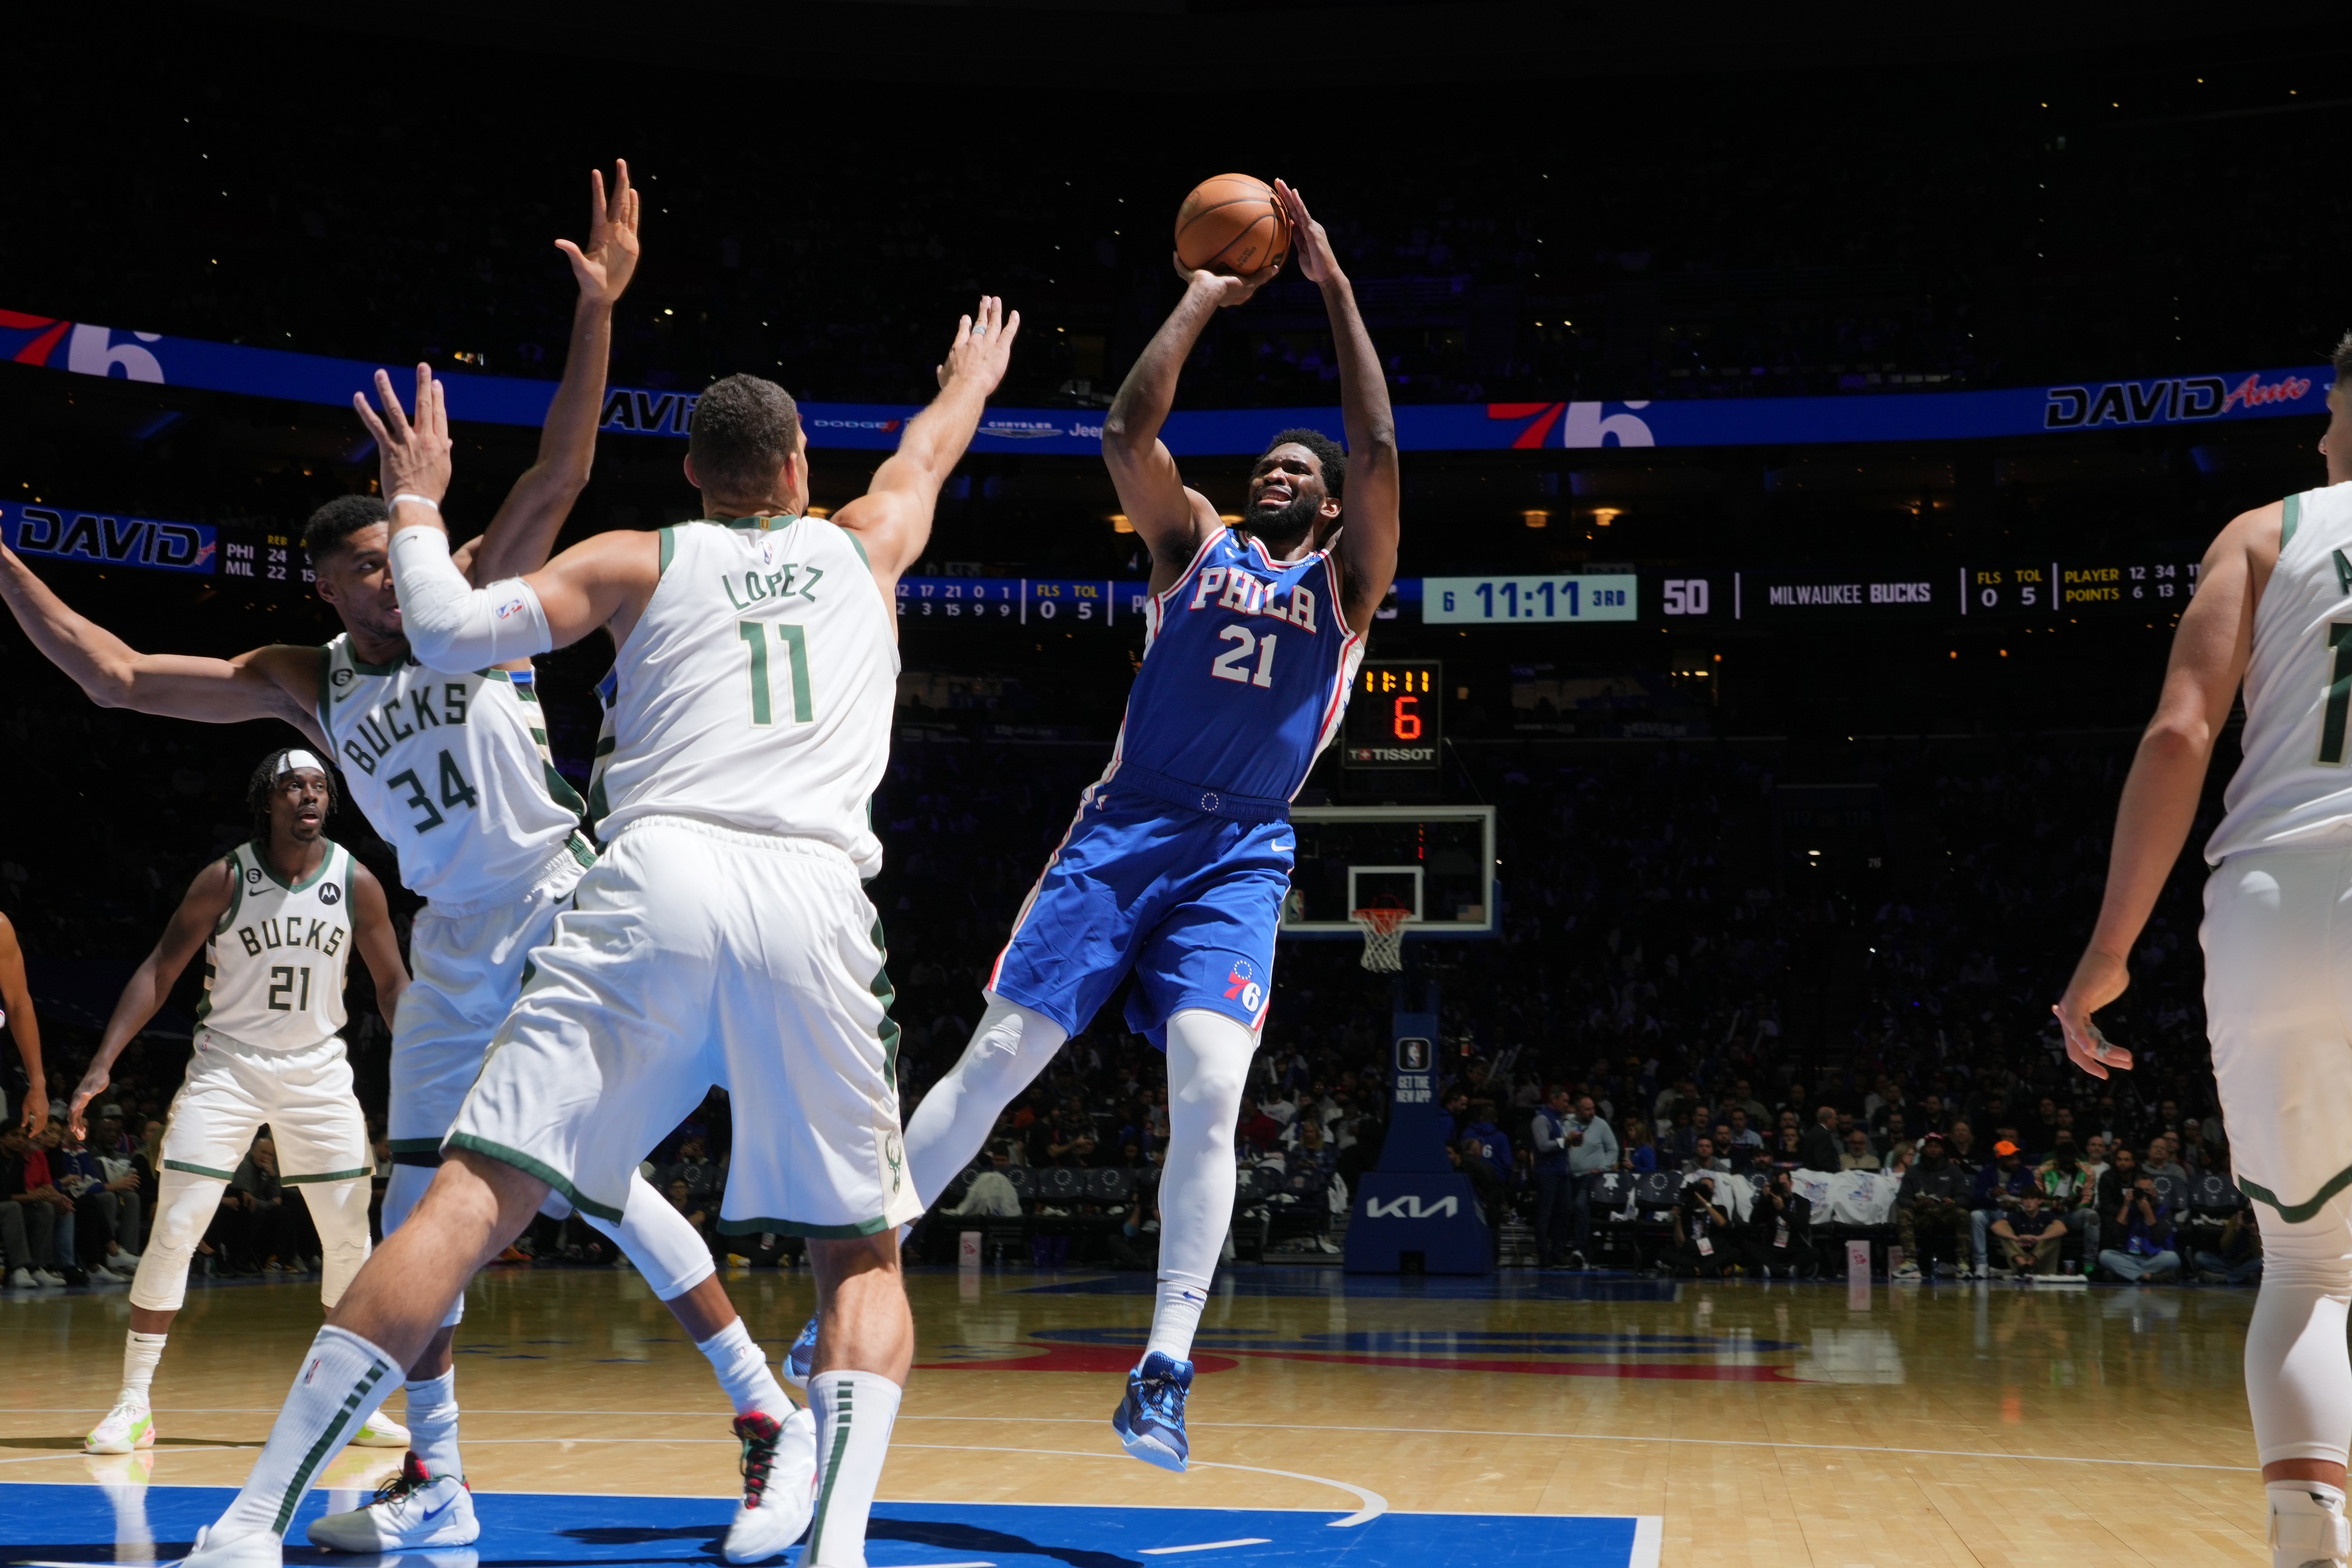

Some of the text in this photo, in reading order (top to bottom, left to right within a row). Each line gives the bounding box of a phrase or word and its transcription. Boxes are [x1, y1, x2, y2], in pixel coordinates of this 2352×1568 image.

[599, 389, 700, 435] AVI
[2044, 374, 2310, 429] DAVID Auto
[17, 507, 200, 568] DAVID
[226, 542, 254, 560] PHI
[267, 547, 288, 563] 24
[225, 560, 317, 583] MIL 22 15
[1978, 569, 2043, 585] FLS TOL
[2064, 567, 2121, 584] PLAYER
[2129, 566, 2146, 580] 12
[2154, 564, 2177, 578] 34
[722, 563, 824, 610] LOPEZ
[919, 584, 935, 598] 17
[945, 585, 961, 599] 21
[972, 585, 985, 599] 0
[1001, 586, 1010, 600] 1
[1037, 584, 1098, 598] FLS TOL
[1663, 579, 1709, 615] 50
[1770, 582, 1931, 605] MILWAUKEE BUCKS
[1981, 586, 2036, 607] 0 5
[2066, 587, 2121, 602] POINTS
[2132, 585, 2144, 599] 6
[2157, 583, 2175, 598] 13
[922, 602, 932, 616] 3
[945, 602, 961, 617] 15
[973, 602, 985, 617] 9
[999, 603, 1010, 618] 9
[1039, 600, 1092, 620] 0 5
[1189, 566, 1317, 635] PHILA
[1443, 581, 1626, 618] 6 11:11 3RD
[1211, 624, 1277, 689] 21
[737, 617, 817, 729] 11
[1366, 671, 1429, 692] 11:11
[343, 683, 467, 776] BUCKS
[1394, 696, 1421, 739] 6
[1372, 748, 1435, 761] TISSOT
[386, 749, 479, 835] 34
[238, 916, 345, 958] BUCKS
[267, 965, 311, 1012] 21
[1223, 970, 1261, 1013] 76
[1397, 1075, 1430, 1089] GET THE
[1396, 1089, 1432, 1103] NEW APP
[1367, 1195, 1458, 1219] KIA
